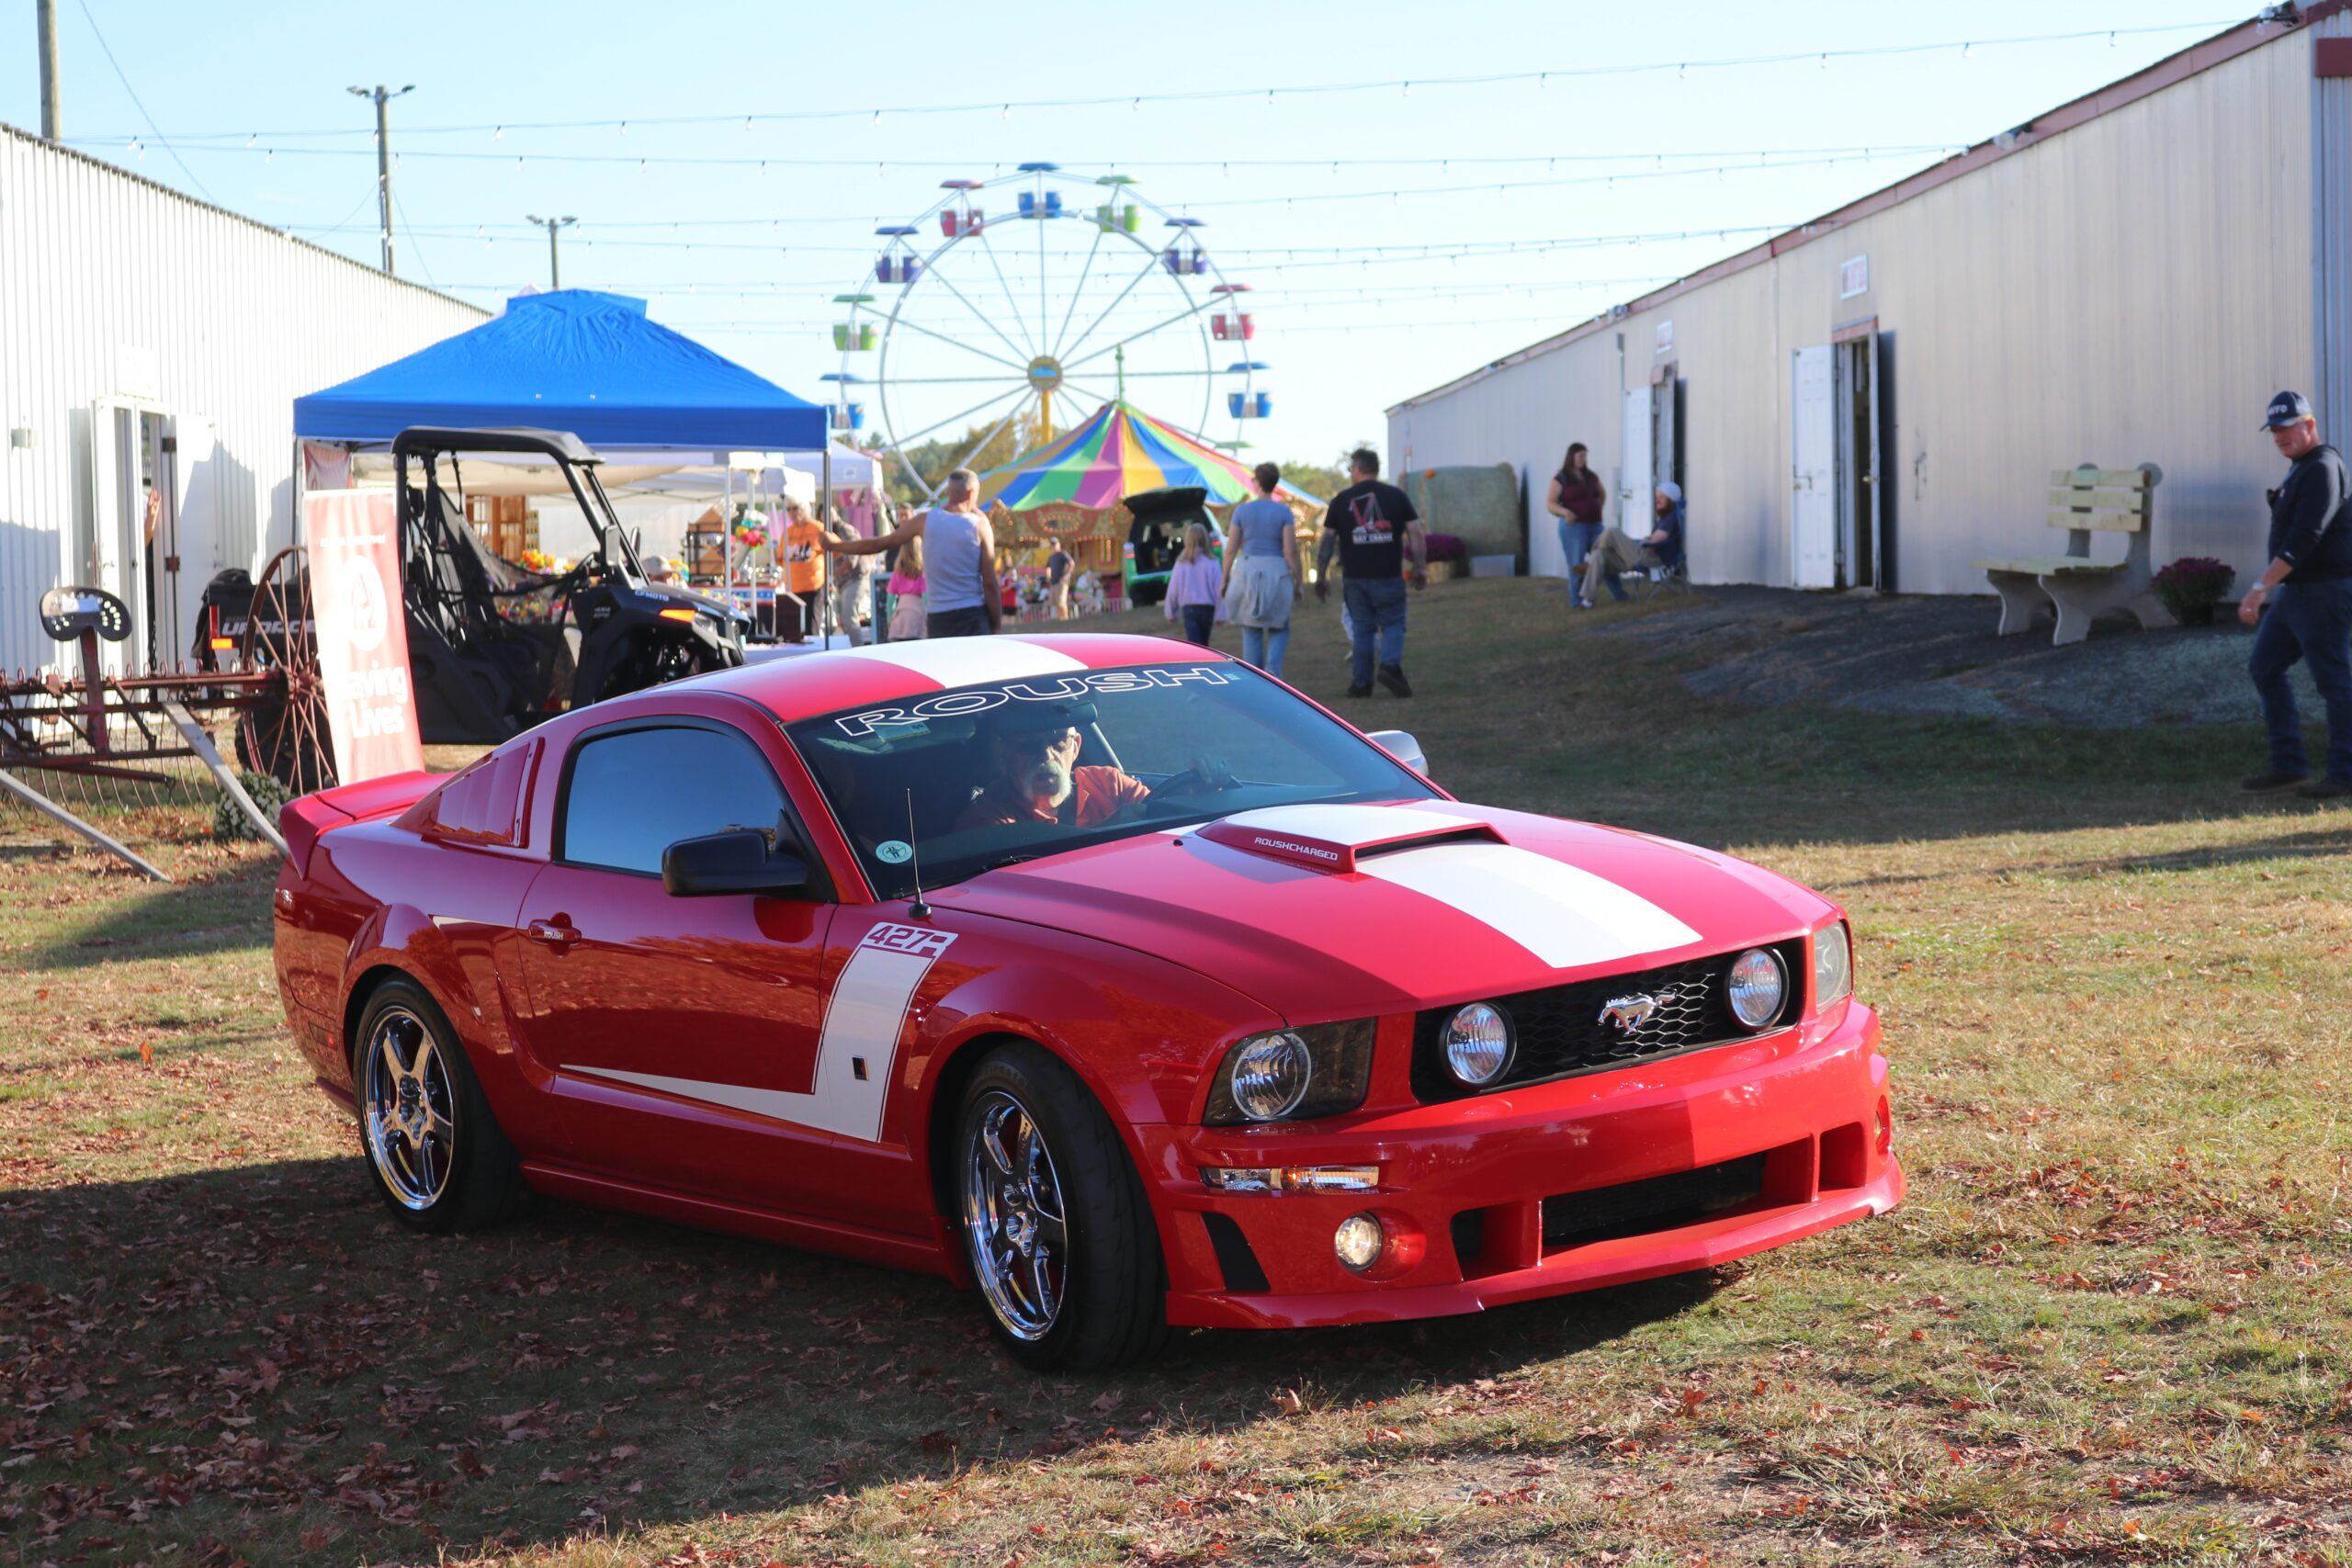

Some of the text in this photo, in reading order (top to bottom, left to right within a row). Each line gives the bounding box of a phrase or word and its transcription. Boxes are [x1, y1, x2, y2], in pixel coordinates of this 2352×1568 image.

[634, 590, 670, 603] CFMOTO
[834, 667, 1228, 737] ROUSH
[349, 699, 405, 739] Lives
[1254, 837, 1339, 862] ROUSHCHARGED
